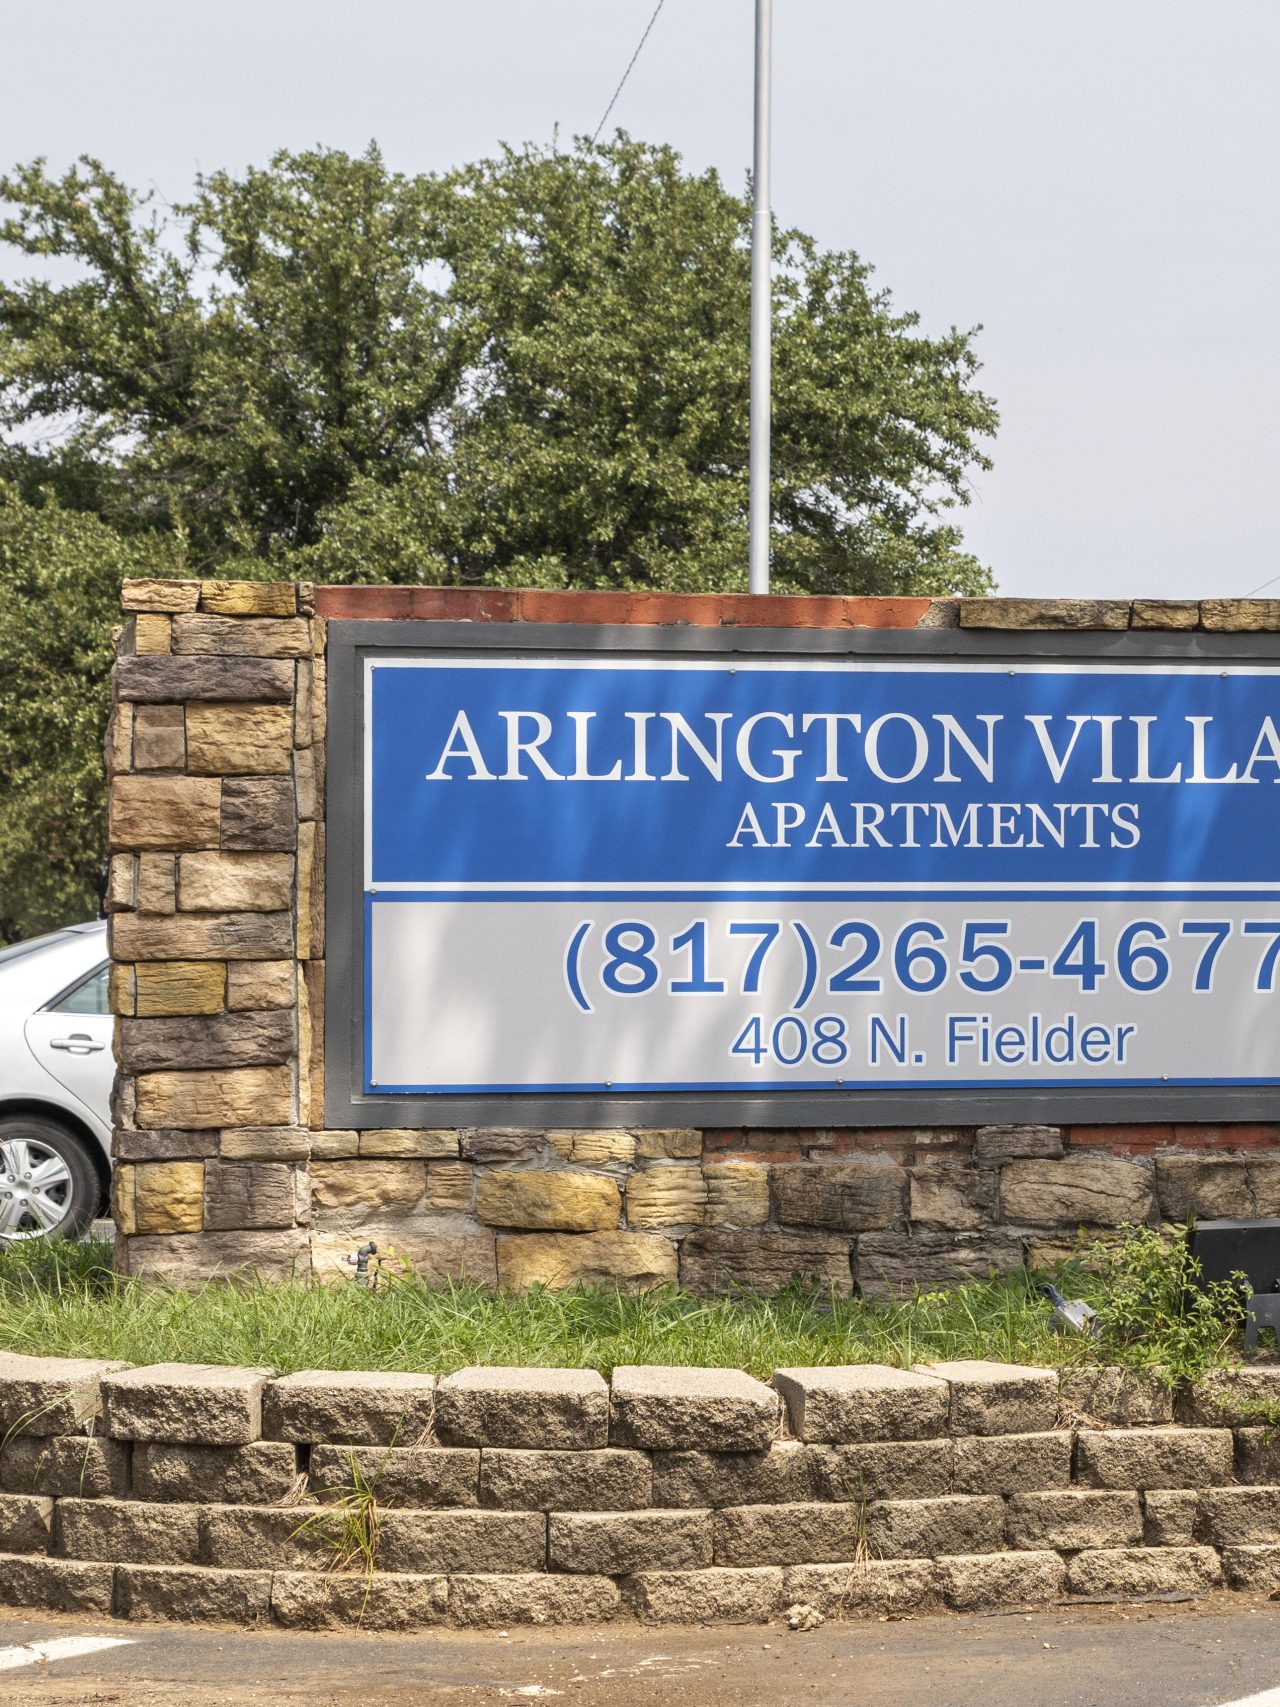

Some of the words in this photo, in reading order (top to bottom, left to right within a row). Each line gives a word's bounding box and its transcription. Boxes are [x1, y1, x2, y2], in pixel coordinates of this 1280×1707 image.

[426, 709, 1004, 783] ARLINGTON
[725, 801, 1142, 849] APARTMENTS
[729, 1014, 849, 1067] 408
[869, 1014, 924, 1066] N.
[946, 1013, 1136, 1065] Fielder
